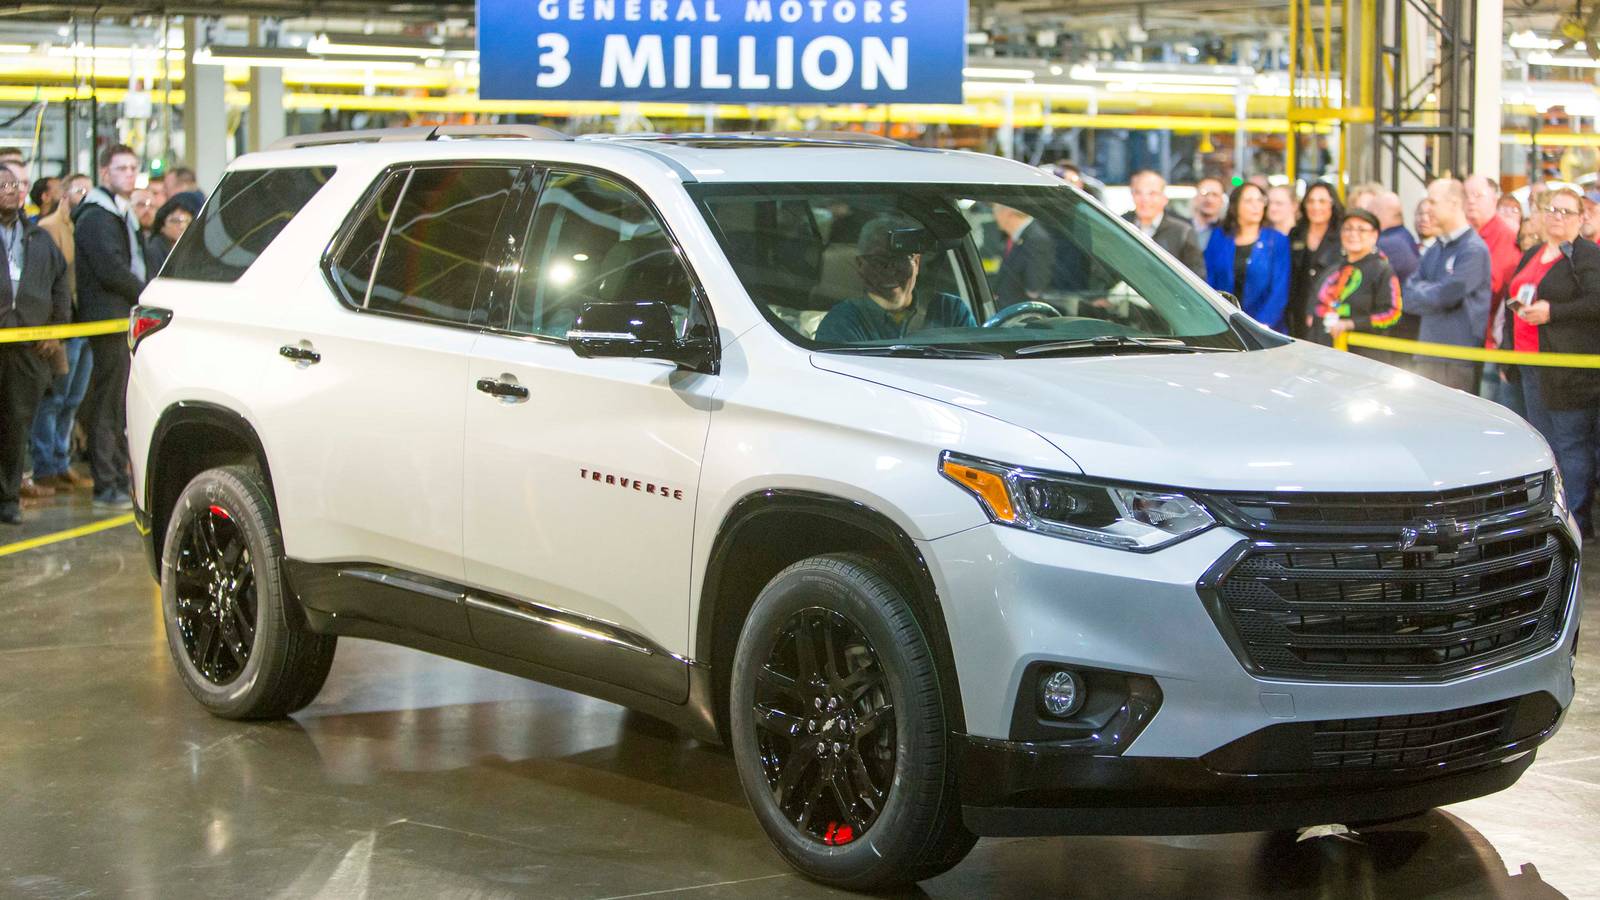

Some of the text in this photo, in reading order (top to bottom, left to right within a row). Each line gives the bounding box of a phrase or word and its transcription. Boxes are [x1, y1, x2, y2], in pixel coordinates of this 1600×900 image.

[538, 0, 908, 23] GENERAL MOTORS
[536, 33, 908, 91] 3 MILLION
[580, 468, 683, 500] TRAVERSE
